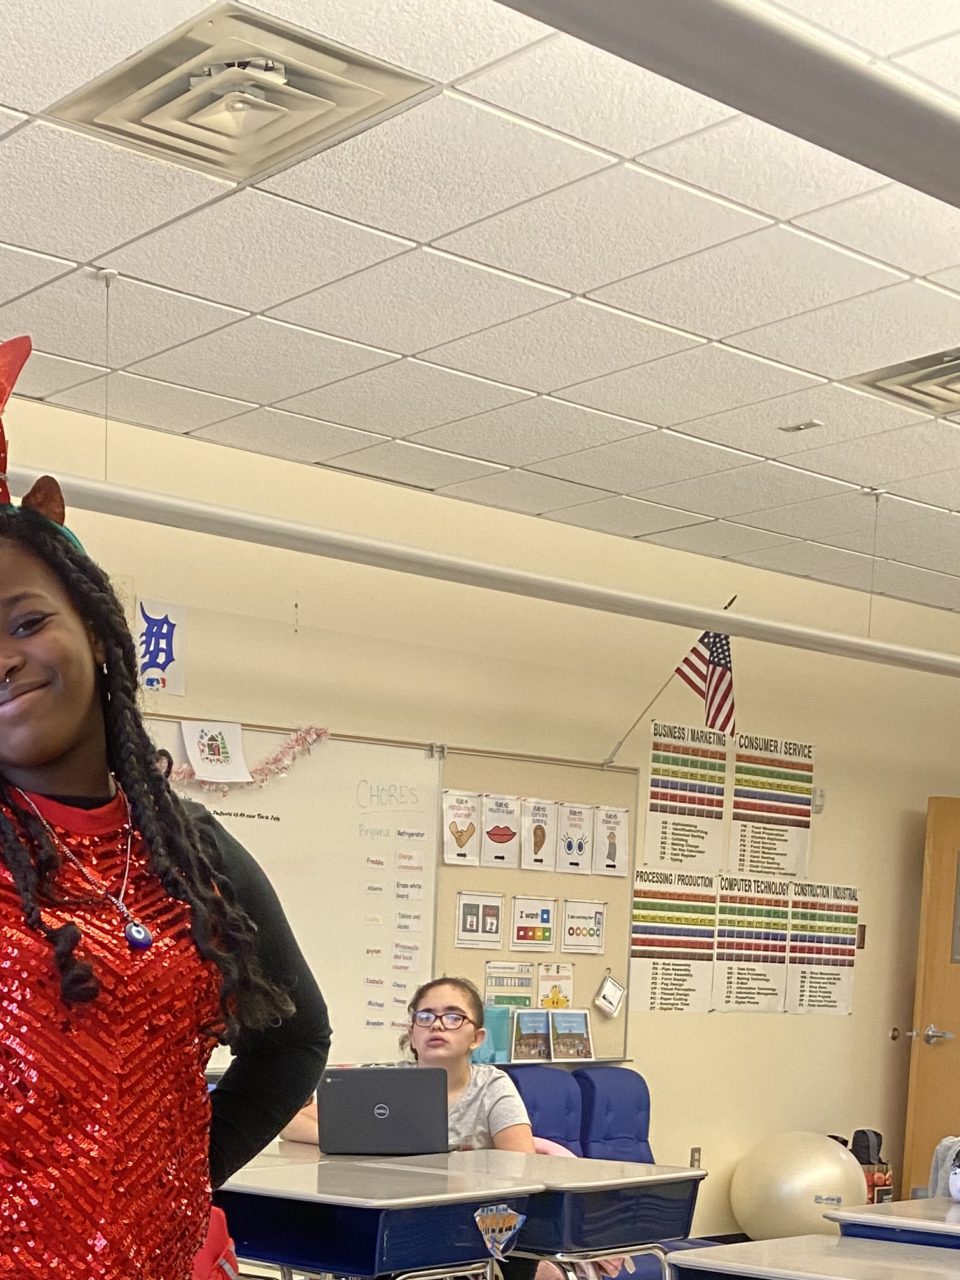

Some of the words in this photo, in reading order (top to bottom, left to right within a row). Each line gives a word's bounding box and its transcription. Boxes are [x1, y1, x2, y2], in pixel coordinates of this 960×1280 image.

[653, 723, 685, 740] BUSINESS
[691, 729, 726, 747] MARKETING
[739, 734, 778, 754] CONSUMER
[784, 741, 812, 759] SERVICE
[356, 779, 420, 808] CHORES
[635, 871, 673, 885] PROCESSING
[677, 874, 713, 888] PRODUCTION
[720, 877, 752, 891] COMPUTER
[753, 879, 789, 896] TECHNOLOGY
[793, 883, 830, 897] CONSTRUCTION
[833, 885, 858, 901] INDUSTRIAL
